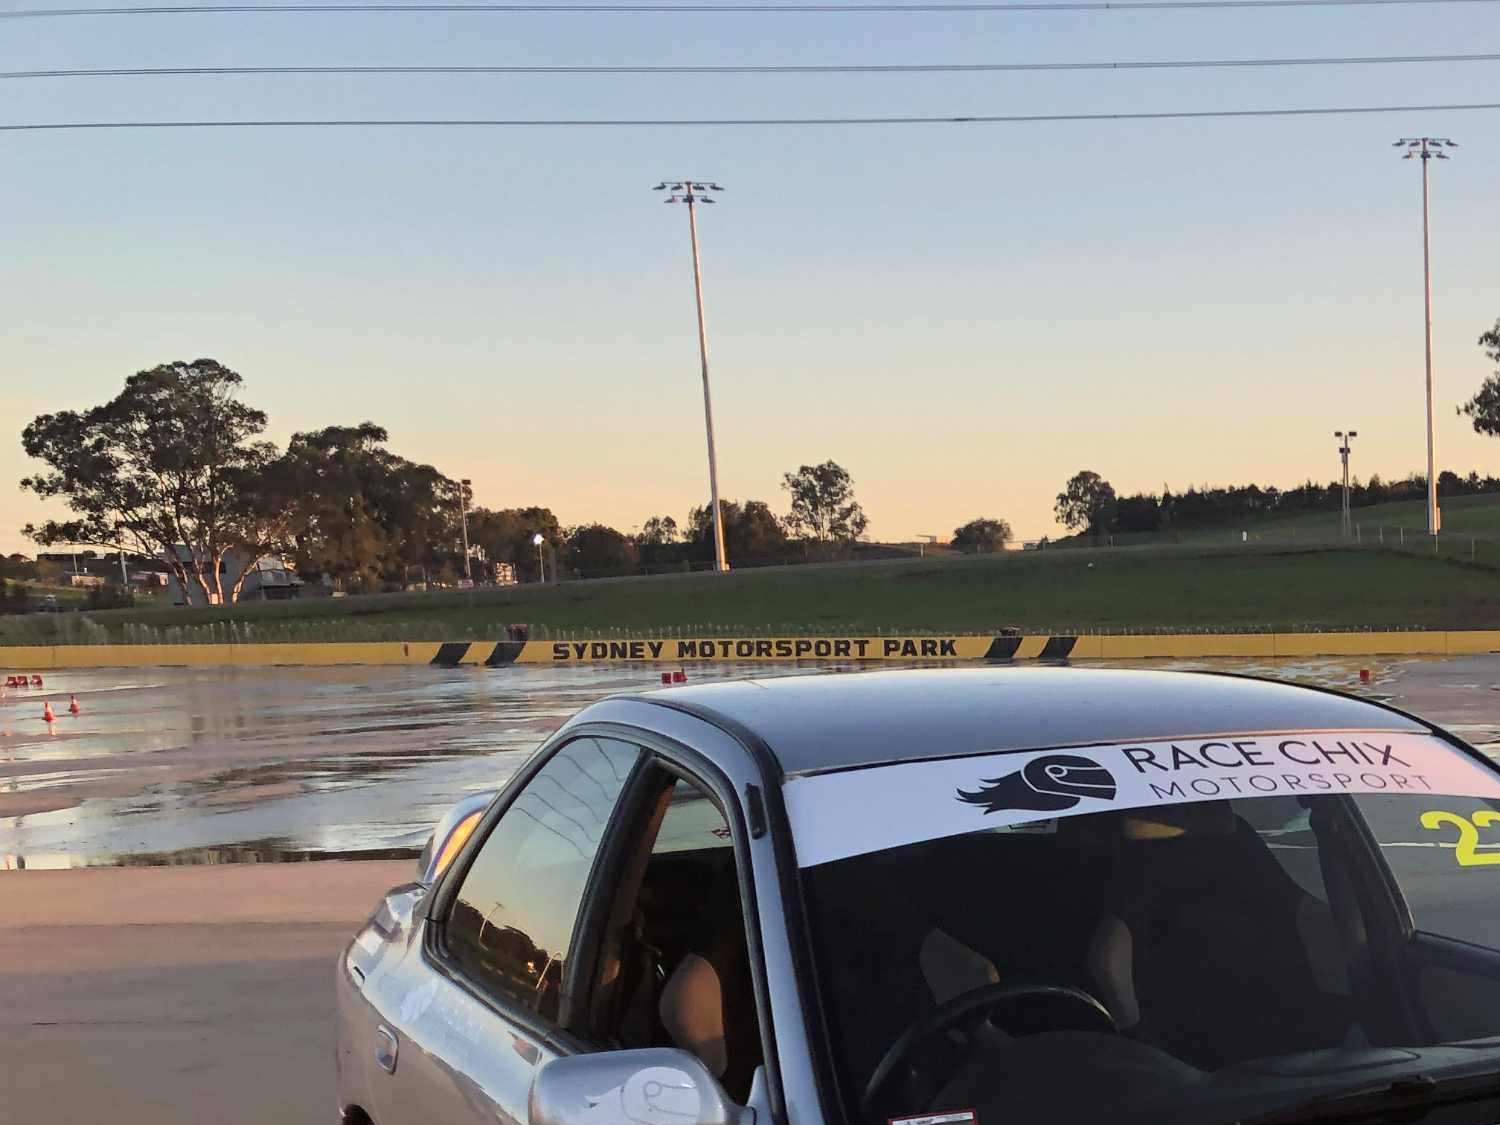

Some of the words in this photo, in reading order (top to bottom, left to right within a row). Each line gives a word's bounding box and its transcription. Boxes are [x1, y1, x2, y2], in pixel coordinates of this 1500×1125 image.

[553, 641, 663, 660] SYDNEY
[677, 639, 870, 659] MOTORSPORT
[884, 639, 957, 657] PARK
[1121, 741, 1275, 773] RACE
[1278, 740, 1412, 768] CHIX
[1149, 772, 1433, 800] MOTORSPORT
